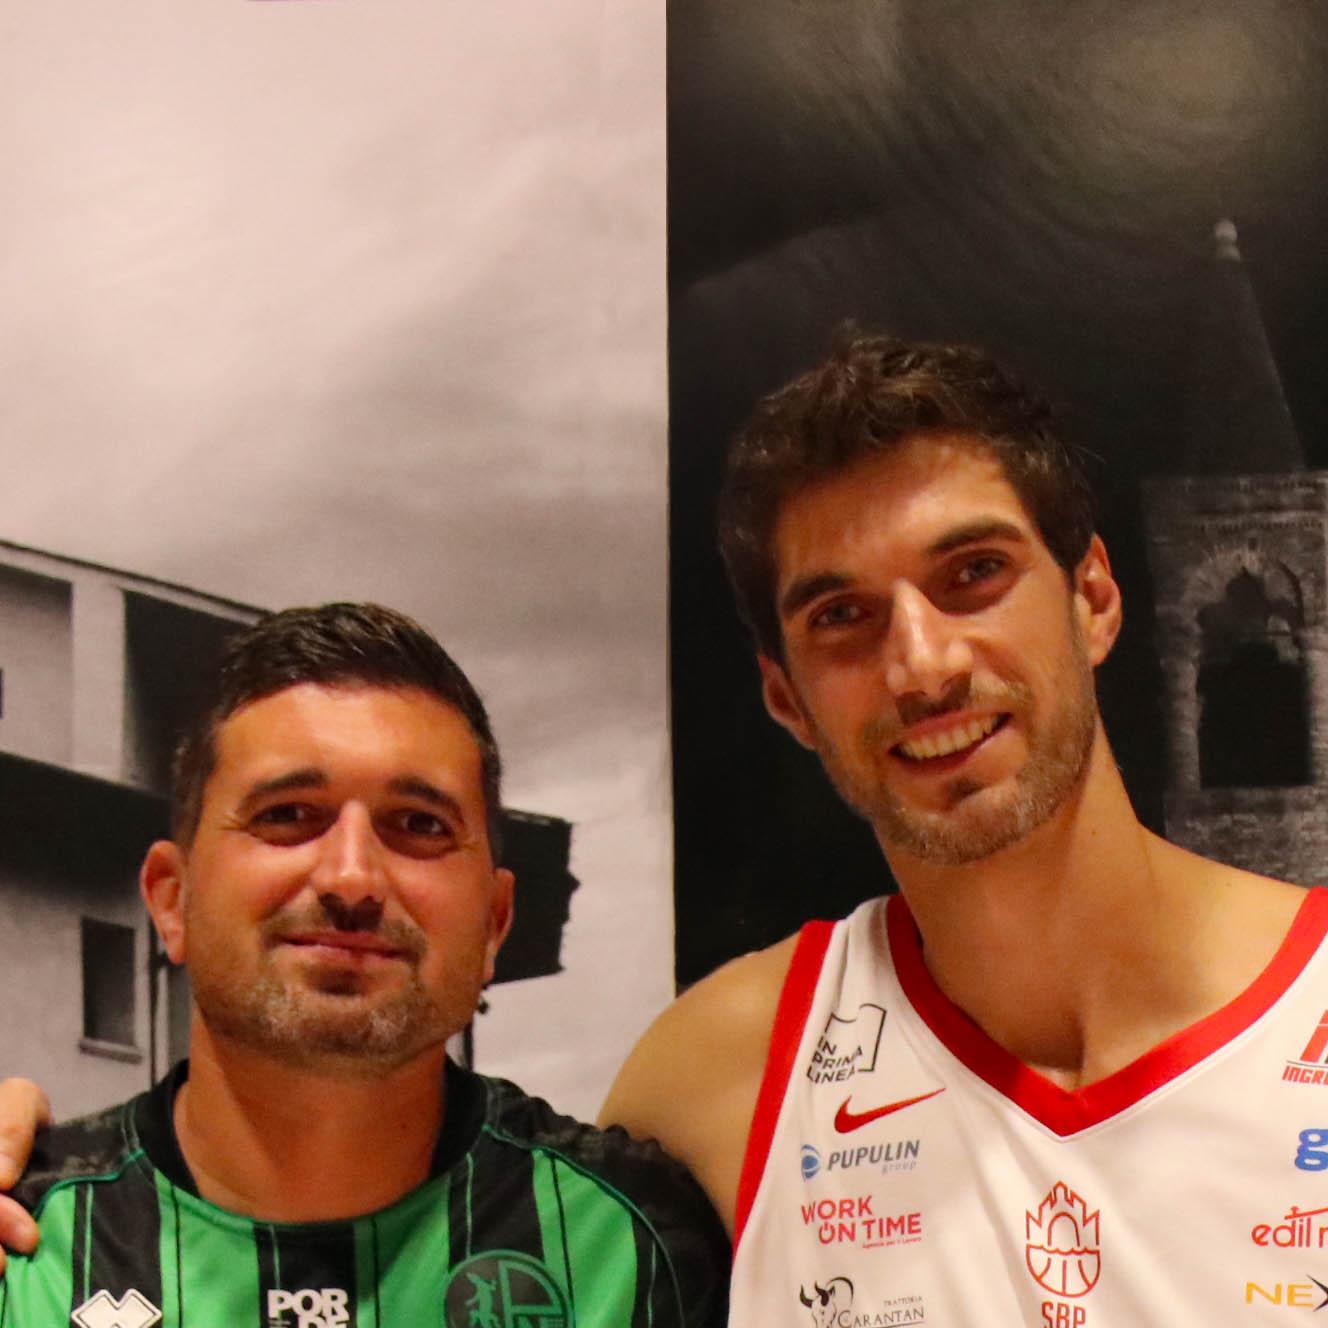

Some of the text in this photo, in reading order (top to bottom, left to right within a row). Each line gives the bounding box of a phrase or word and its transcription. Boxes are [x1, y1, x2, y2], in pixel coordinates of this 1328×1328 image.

[817, 1035, 837, 1056] IN
[827, 1139, 920, 1171] PUPULIN
[801, 1195, 873, 1225] WORK
[818, 1220, 856, 1245] ON
[862, 1212, 922, 1239] TIME
[267, 1288, 350, 1320] POR
[837, 1306, 925, 1328] CARANTAN
